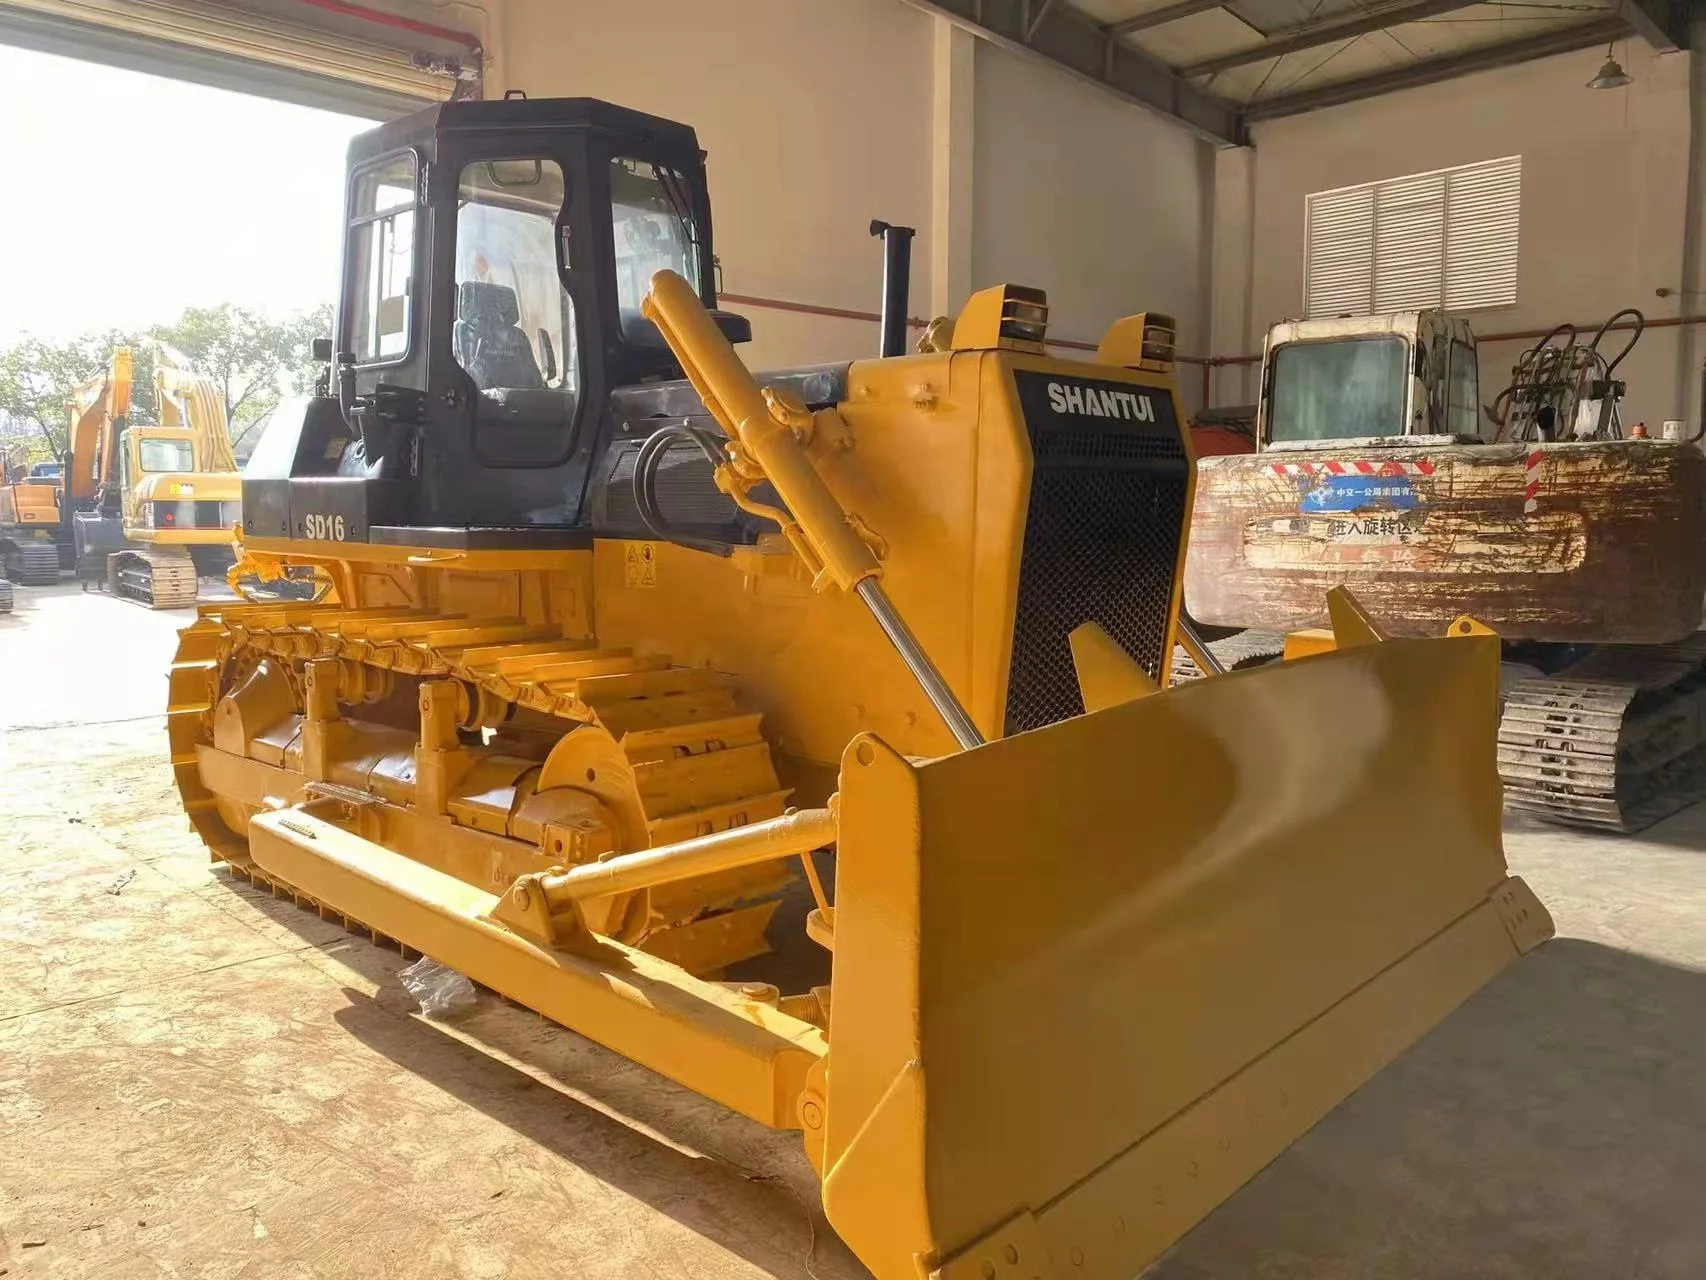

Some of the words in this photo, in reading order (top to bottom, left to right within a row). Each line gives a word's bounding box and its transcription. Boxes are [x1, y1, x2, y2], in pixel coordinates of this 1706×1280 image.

[1047, 382, 1155, 423] SHANTUI
[1336, 486, 1417, 498] 中交一公局集团有
[305, 513, 345, 542] SD16
[1335, 517, 1422, 536] 进入旋转区
